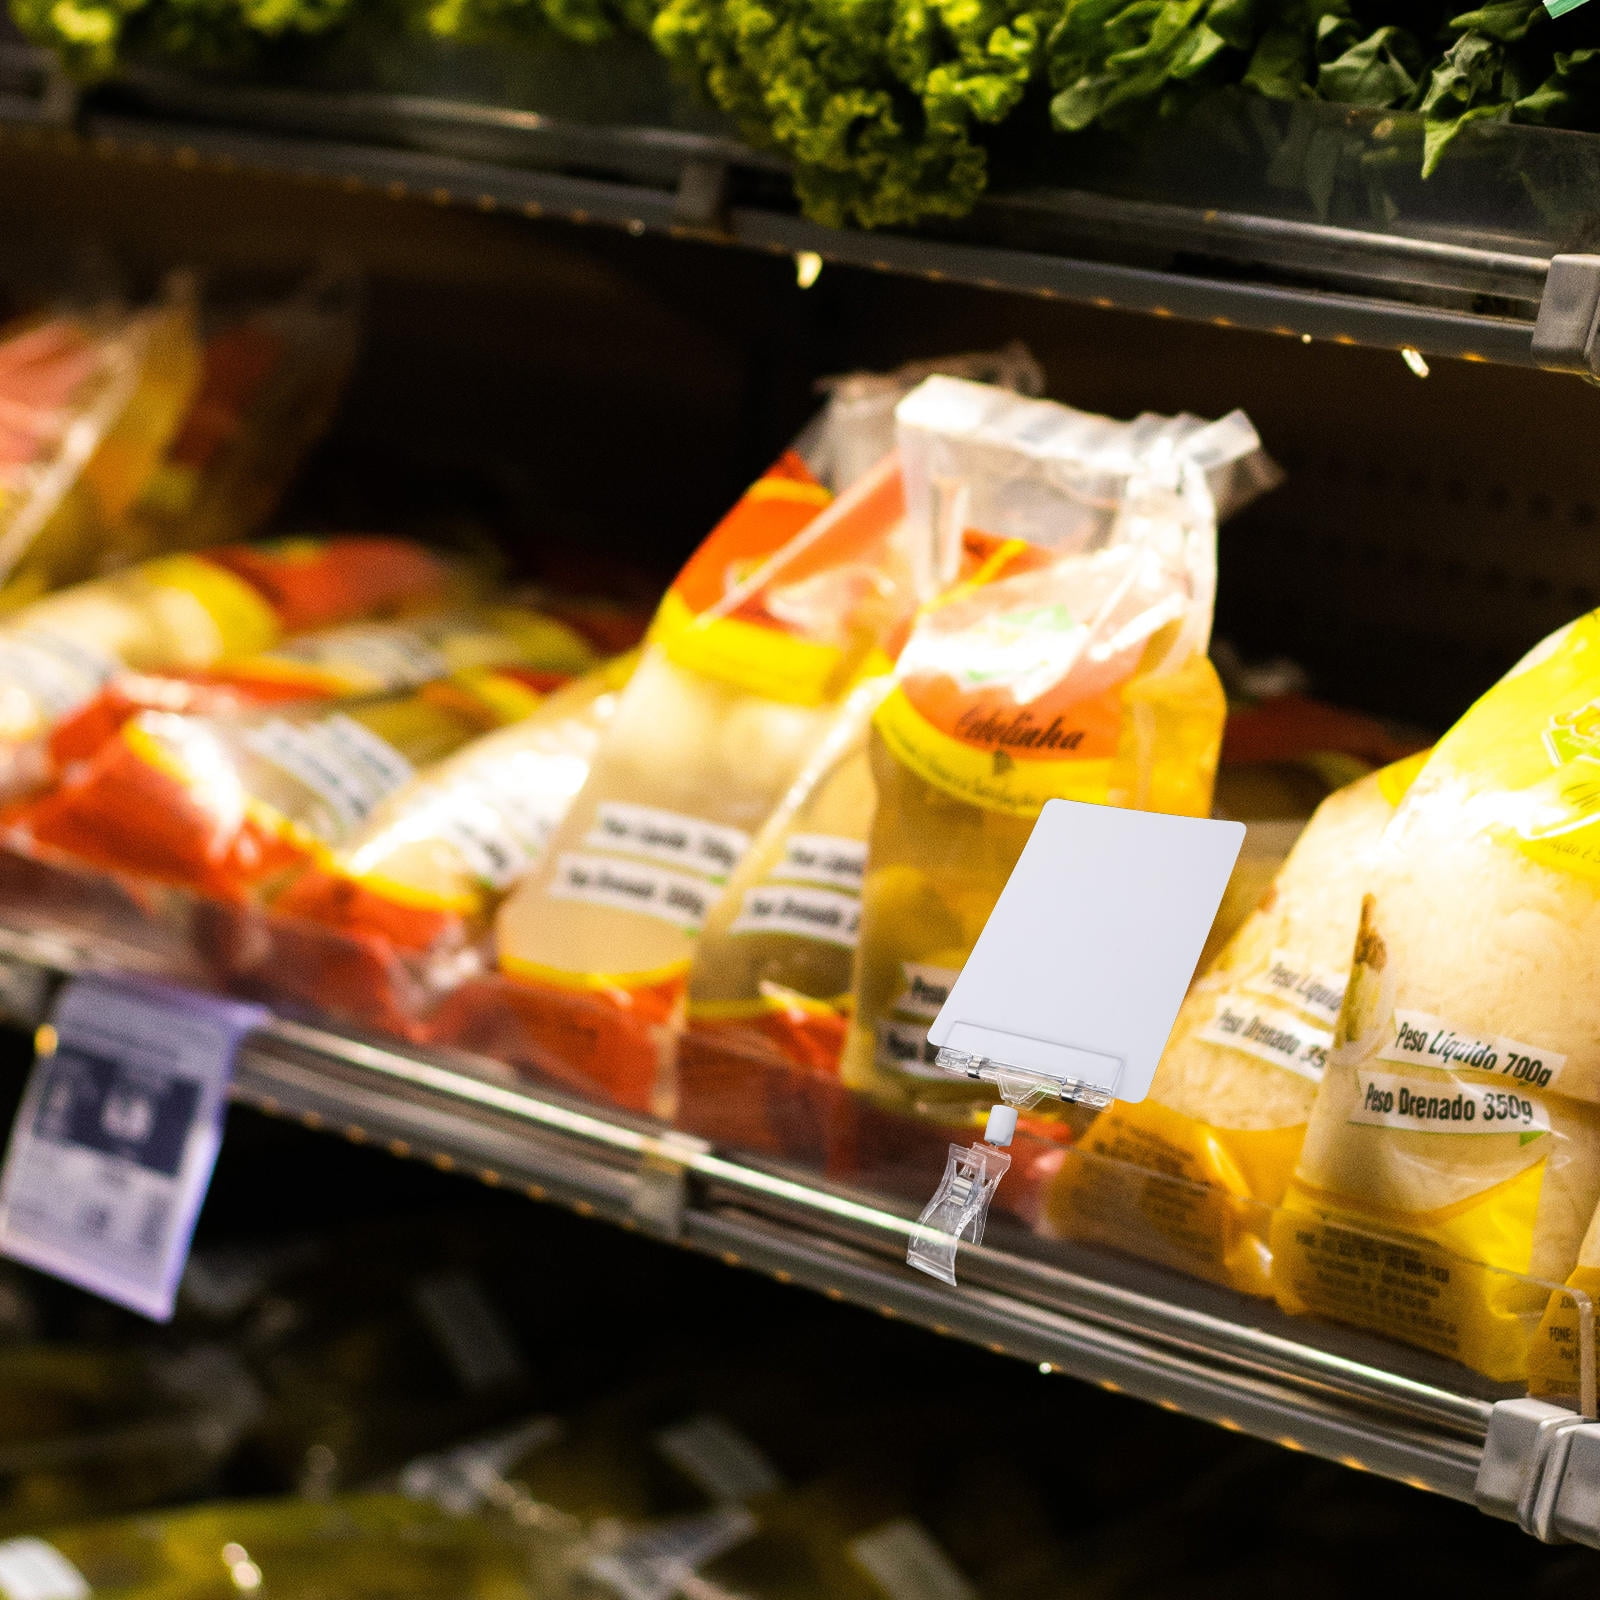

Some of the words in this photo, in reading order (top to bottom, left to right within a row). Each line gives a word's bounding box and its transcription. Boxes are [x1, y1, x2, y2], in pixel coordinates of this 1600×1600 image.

[1300, 1044, 1328, 1069] 35
[1395, 1022, 1428, 1051] Peso
[1428, 1030, 1497, 1069] Líquido
[1502, 1052, 1553, 1088] 700g
[1365, 1082, 1394, 1113] Peso
[1398, 1087, 1475, 1121] Drenado
[1483, 1093, 1533, 1125] 350g
